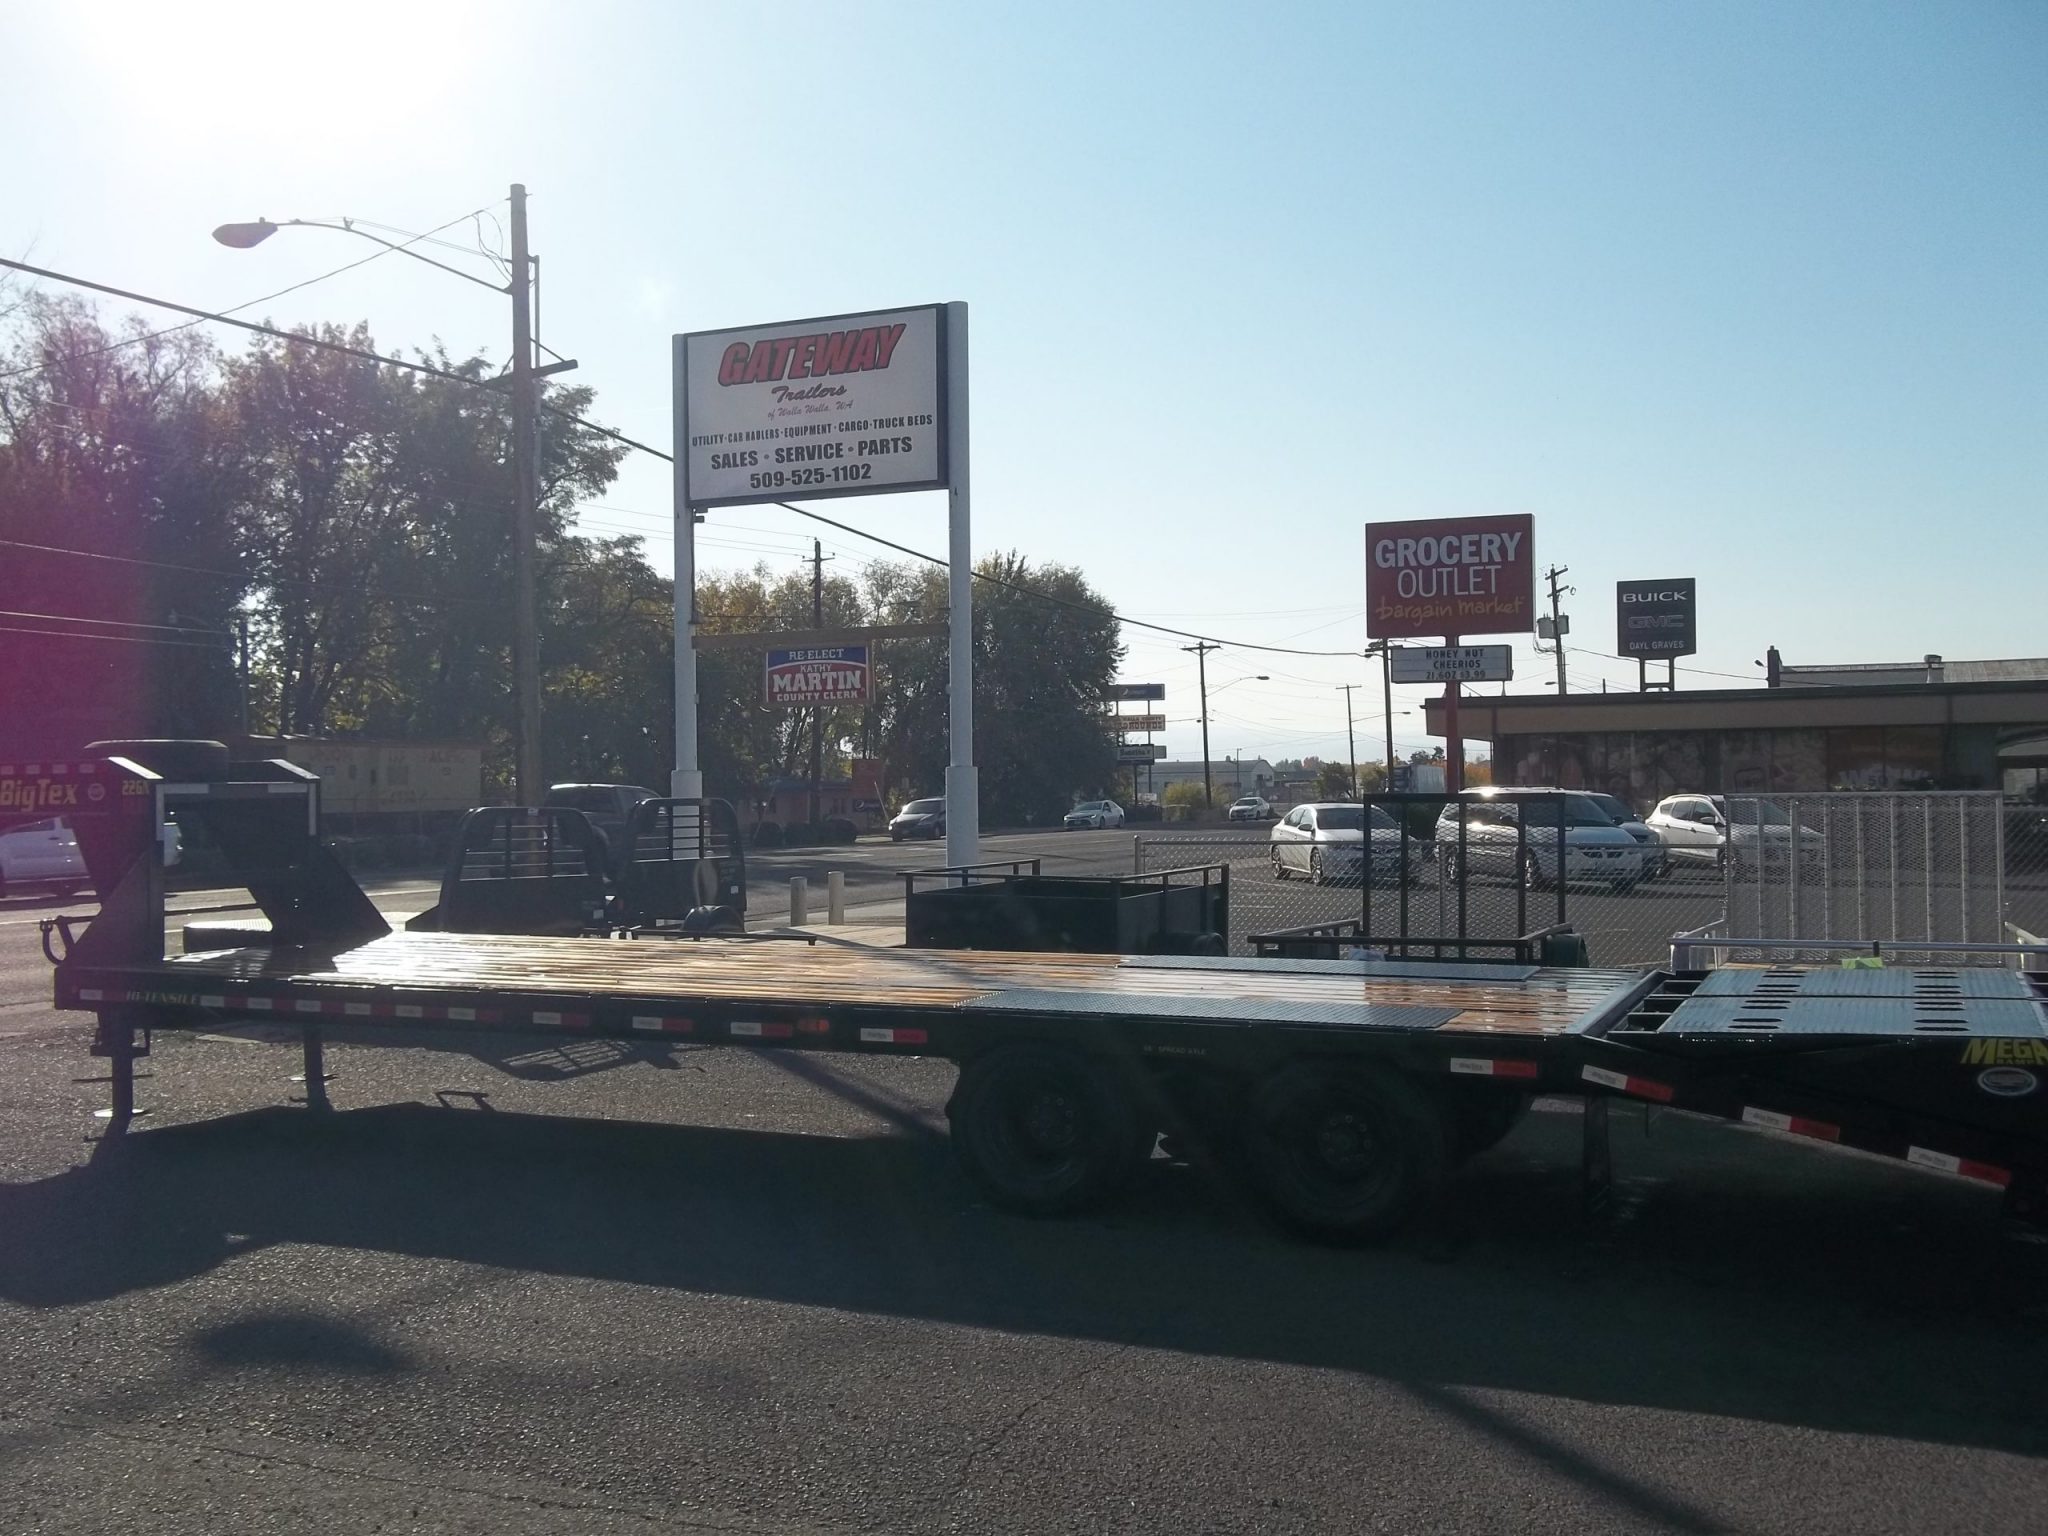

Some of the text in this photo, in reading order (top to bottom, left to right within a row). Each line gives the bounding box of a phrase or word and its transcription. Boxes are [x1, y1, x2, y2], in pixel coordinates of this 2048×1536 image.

[718, 323, 907, 387] GATEWAY
[771, 383, 847, 404] Trailers
[768, 408, 775, 421] of
[777, 406, 802, 417] Walla
[692, 434, 724, 447] UTILITY
[784, 423, 832, 438] EQUIPMENT
[838, 420, 869, 433] CARGO
[873, 416, 905, 430] TRUCK
[907, 414, 933, 426] BEDS
[711, 436, 913, 470] SALES SERVICE PARTS
[750, 463, 872, 489] 509-525-1102
[1375, 531, 1522, 568] GROCERY
[1397, 565, 1502, 599] OUTLET
[1622, 590, 1688, 603] BUICK
[1375, 594, 1524, 627] bargain market
[1628, 614, 1685, 629] GMC
[789, 648, 845, 660] RE-ELECT
[1426, 648, 1485, 659] HONEY NUT
[1651, 640, 1685, 649] GRAVES
[800, 663, 832, 673] KATHY
[1433, 659, 1481, 670] CHEERIOS
[772, 670, 862, 693] MARTIN
[776, 690, 859, 702] COUNTY CLERK
[1960, 1038, 2048, 1065] MEGA
